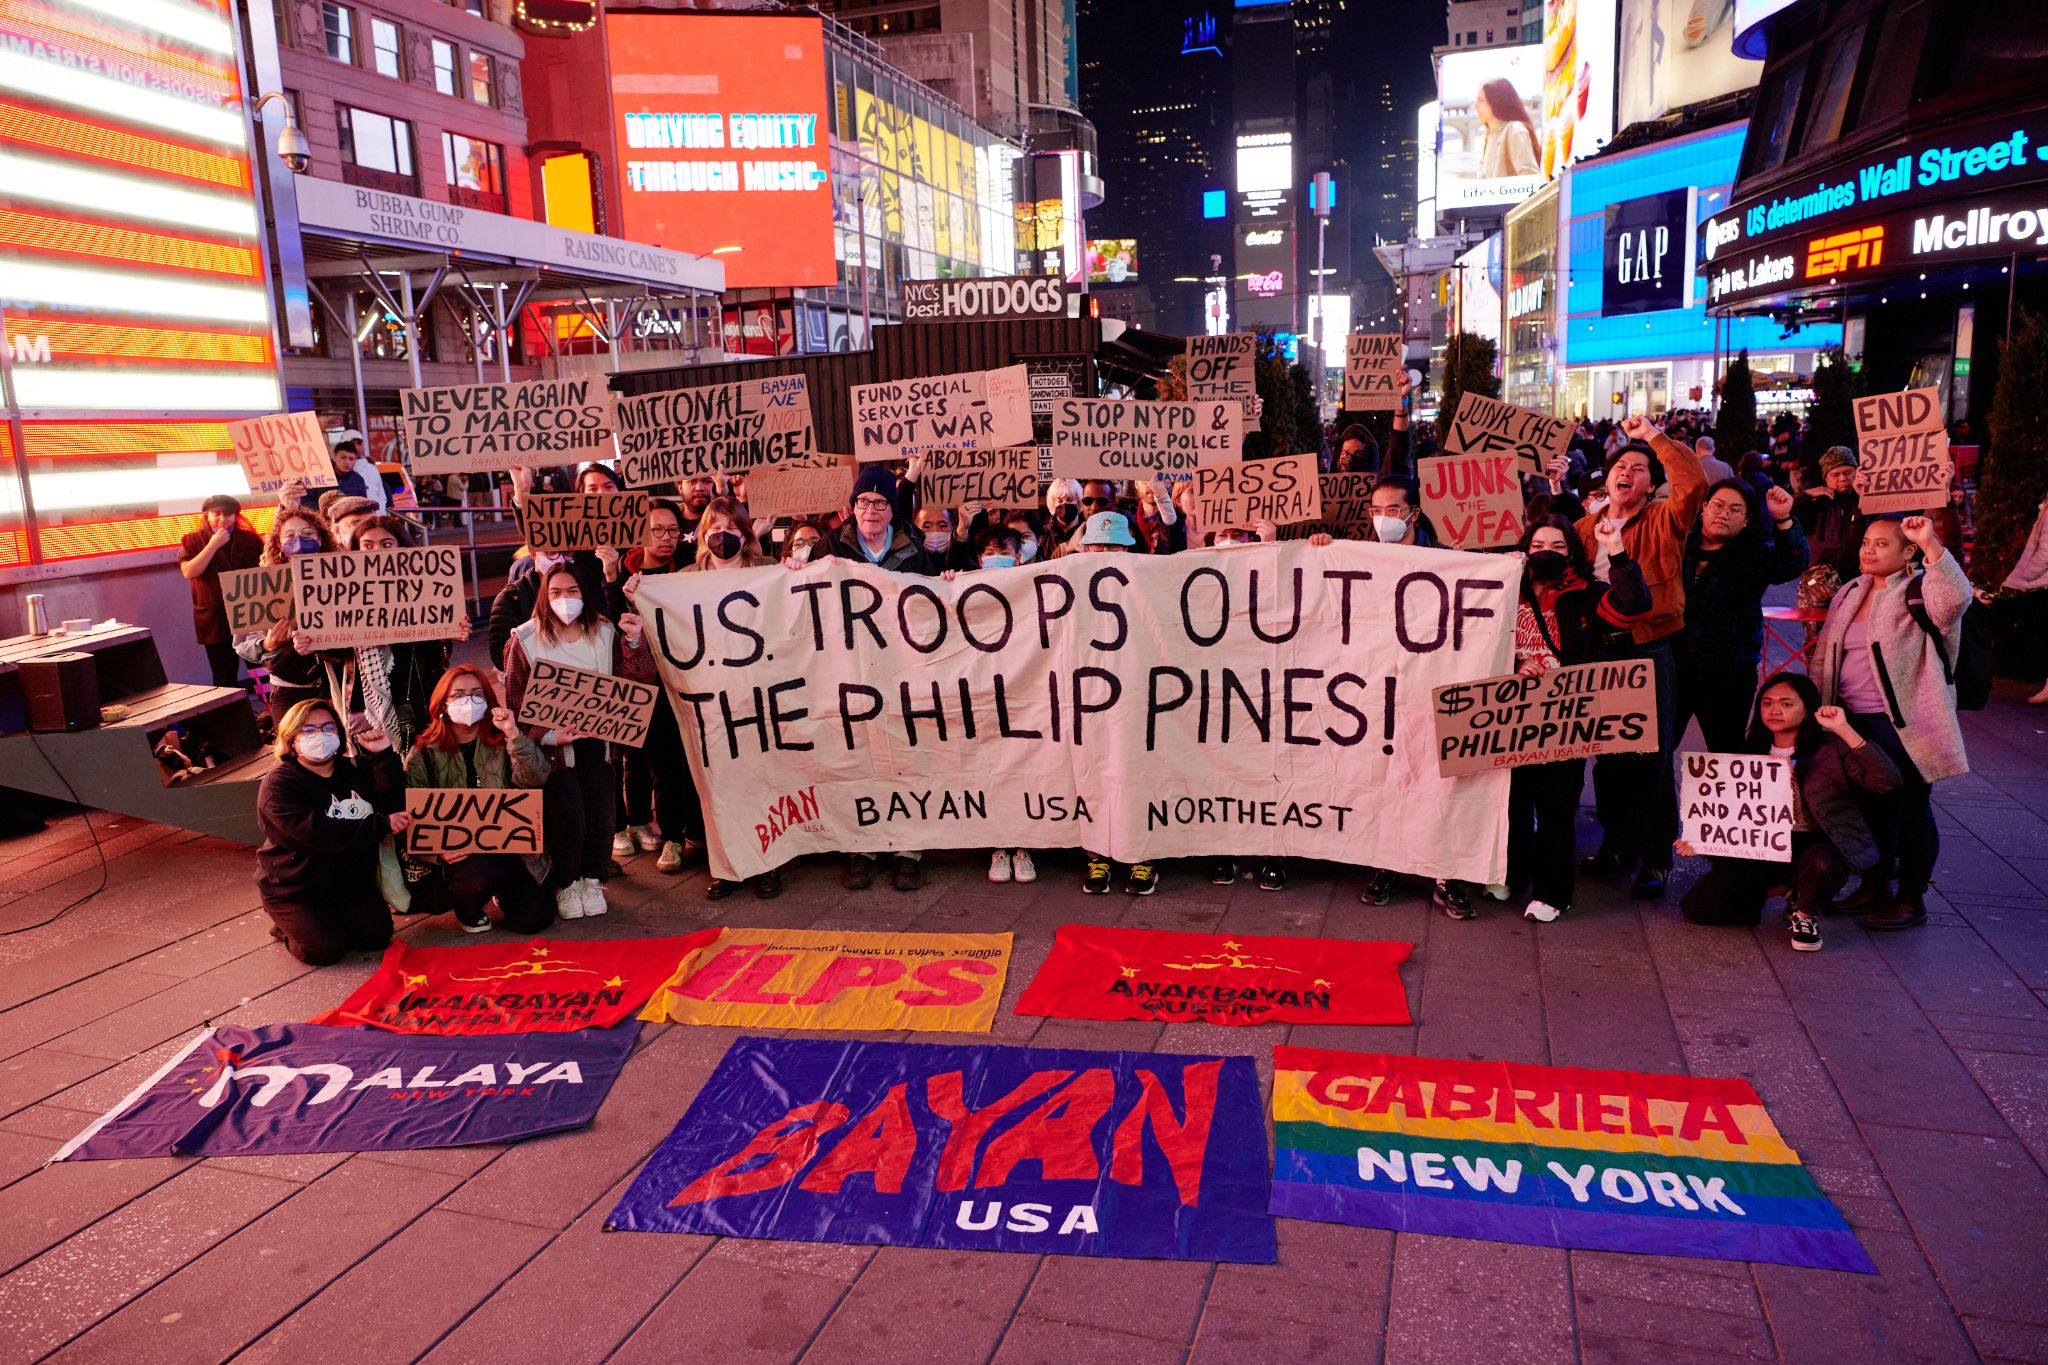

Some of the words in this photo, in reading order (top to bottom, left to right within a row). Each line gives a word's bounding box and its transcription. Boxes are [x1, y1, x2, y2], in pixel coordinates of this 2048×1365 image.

[625, 112, 725, 149] DRIVING
[729, 112, 817, 150] EQUITY
[1236, 132, 1292, 148] SAMSUNG
[627, 161, 739, 192] THROUGH
[743, 161, 825, 192] MUSIC
[1499, 182, 1536, 198] Good
[1746, 204, 1766, 237] US
[1767, 180, 1854, 231] determines
[1859, 155, 1912, 203] Wall
[1918, 129, 2029, 187] Street
[355, 189, 414, 217] BUBBA
[420, 202, 464, 226] GUMP
[370, 214, 432, 241] SHRIMP
[438, 222, 463, 244] CO.
[564, 237, 626, 266] RAISING
[630, 246, 677, 276] CANE'S
[1617, 225, 1669, 285] GAP
[1806, 225, 1885, 278] ESPN
[1748, 254, 1796, 288] Lakers
[905, 283, 940, 301] NYC's
[943, 278, 1062, 318] HOTDOGS
[906, 301, 943, 318] best
[1190, 335, 1253, 357] HANDS
[1349, 336, 1400, 357] JUNK
[1190, 356, 1240, 382] OFF
[1352, 357, 1394, 370] THE
[761, 377, 806, 395] BAYAN
[857, 385, 902, 406] FUND
[908, 379, 972, 401] SOCIAL
[1030, 390, 1069, 398] SANDWICHES
[1034, 377, 1064, 386] HOTDOGS
[1190, 380, 1252, 394] THE
[1349, 374, 1394, 391] VFA
[407, 386, 509, 415] NEVER
[515, 381, 588, 409] AGAIN
[617, 384, 758, 431] NATIONAL
[767, 392, 801, 407] NE
[858, 399, 947, 422] SERVICES
[1034, 402, 1053, 410] PANI
[1857, 392, 1931, 433] END
[408, 414, 450, 436] TO
[465, 406, 604, 434] MARCOS
[863, 418, 919, 446] NOT
[931, 411, 995, 439] WAR
[1061, 401, 1125, 428] STOP
[1133, 405, 1195, 430] NYPD
[1211, 404, 1229, 431] &
[1459, 396, 1517, 435] JUNK
[1519, 412, 1565, 451] THE
[237, 415, 314, 452] JUNK
[414, 428, 612, 458] DICTATORSHIP
[621, 413, 766, 455] SOVEREIGNTY
[962, 440, 977, 448] NE
[1056, 430, 1157, 449] PHILIPPINE
[1166, 432, 1230, 449] POLICE
[243, 445, 324, 478] EDCA
[624, 445, 709, 485] CHARTER
[710, 425, 811, 471] CHANGE!
[923, 449, 996, 470] ABOLISH
[996, 450, 1032, 470] THE
[1099, 450, 1198, 470] COLLUSION
[1861, 430, 1947, 471] STATE
[314, 475, 327, 486] NE
[774, 473, 796, 489] OUT
[825, 469, 848, 486] THE
[923, 472, 1036, 504] NTF-ELCAC
[1157, 471, 1193, 482] BAYAN
[1196, 461, 1299, 497] PASS
[1319, 474, 1374, 498] ROOPS
[1426, 456, 1518, 500] JUNK
[1864, 462, 1942, 493] TERROR
[526, 494, 648, 519] NTF-ELCAC
[751, 485, 848, 510] PHILIPPINES!
[1201, 498, 1237, 527] THE
[1245, 485, 1313, 524] PHRA!
[1456, 500, 1489, 512] THE
[528, 518, 647, 548] BUWAGIN!
[1442, 510, 1523, 544] VFA
[300, 554, 356, 580] END
[364, 549, 456, 578] MARCOS
[302, 579, 423, 606] PUPPETRY
[432, 581, 454, 599] TO
[300, 610, 323, 630] US
[335, 604, 455, 629] IMPERIALISM
[655, 590, 774, 671] U.S.
[791, 566, 1129, 654] TROOPS
[1180, 567, 1373, 648] OUT
[1394, 570, 1505, 653] OF
[316, 633, 354, 644] BAYAN
[364, 630, 386, 640] USA
[394, 627, 449, 640] NORTHEAST
[533, 661, 651, 706] DEFEND
[1547, 664, 1648, 698] SELLING
[527, 683, 643, 723] NATIONAL
[1470, 703, 1532, 729] OUT
[1540, 696, 1595, 721] THE
[520, 701, 647, 743] SOVEREIGNTY
[678, 677, 815, 768] THE
[1441, 712, 1648, 761] PHILIPPINES
[1493, 752, 1549, 767] BAYAN
[1688, 756, 1719, 781] US
[1729, 760, 1782, 782] OUT
[1699, 781, 1726, 798] OF
[1736, 781, 1762, 800] PH
[411, 792, 533, 826] JUNK
[755, 786, 820, 854] BAYAN
[855, 790, 988, 827] BAYAN
[1024, 791, 1094, 824] USA
[1148, 797, 1353, 832] NORTHEAST
[1688, 801, 1729, 820] AND
[1737, 803, 1793, 826] ASIA
[410, 824, 537, 851] EDCA
[804, 824, 826, 833] USA
[1700, 823, 1787, 852] PACIFIC
[666, 943, 998, 1007] ILPS
[1105, 979, 1332, 1010] ANAKBAYAN
[388, 1089, 450, 1101] NEW
[464, 1086, 536, 1099] YORK
[1307, 1069, 1749, 1146] GABRIELA
[665, 1058, 1225, 1209] BAYAN
[1357, 1146, 1523, 1193] NEW
[1546, 1160, 1746, 1217] YORK
[954, 1200, 1100, 1236] USA
